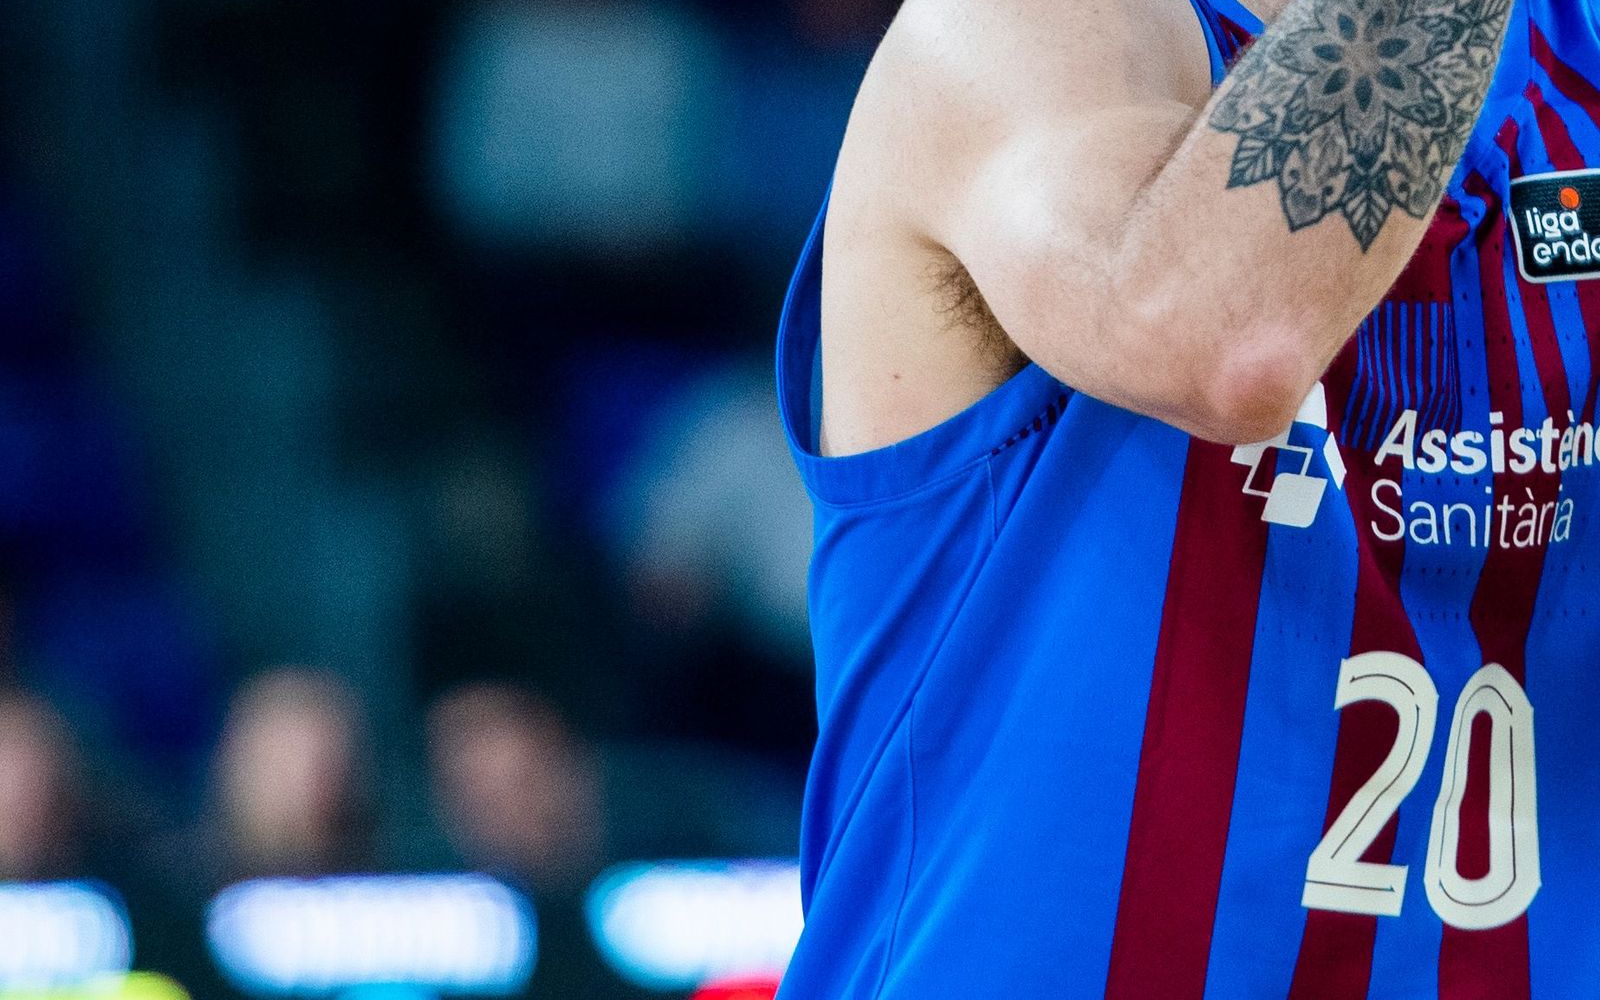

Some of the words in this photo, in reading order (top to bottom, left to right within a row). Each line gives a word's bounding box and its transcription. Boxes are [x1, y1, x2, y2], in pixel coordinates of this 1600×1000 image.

[1525, 206, 1580, 239] liga
[1370, 478, 1574, 549] Sanitària
[1301, 650, 1542, 931] 20
